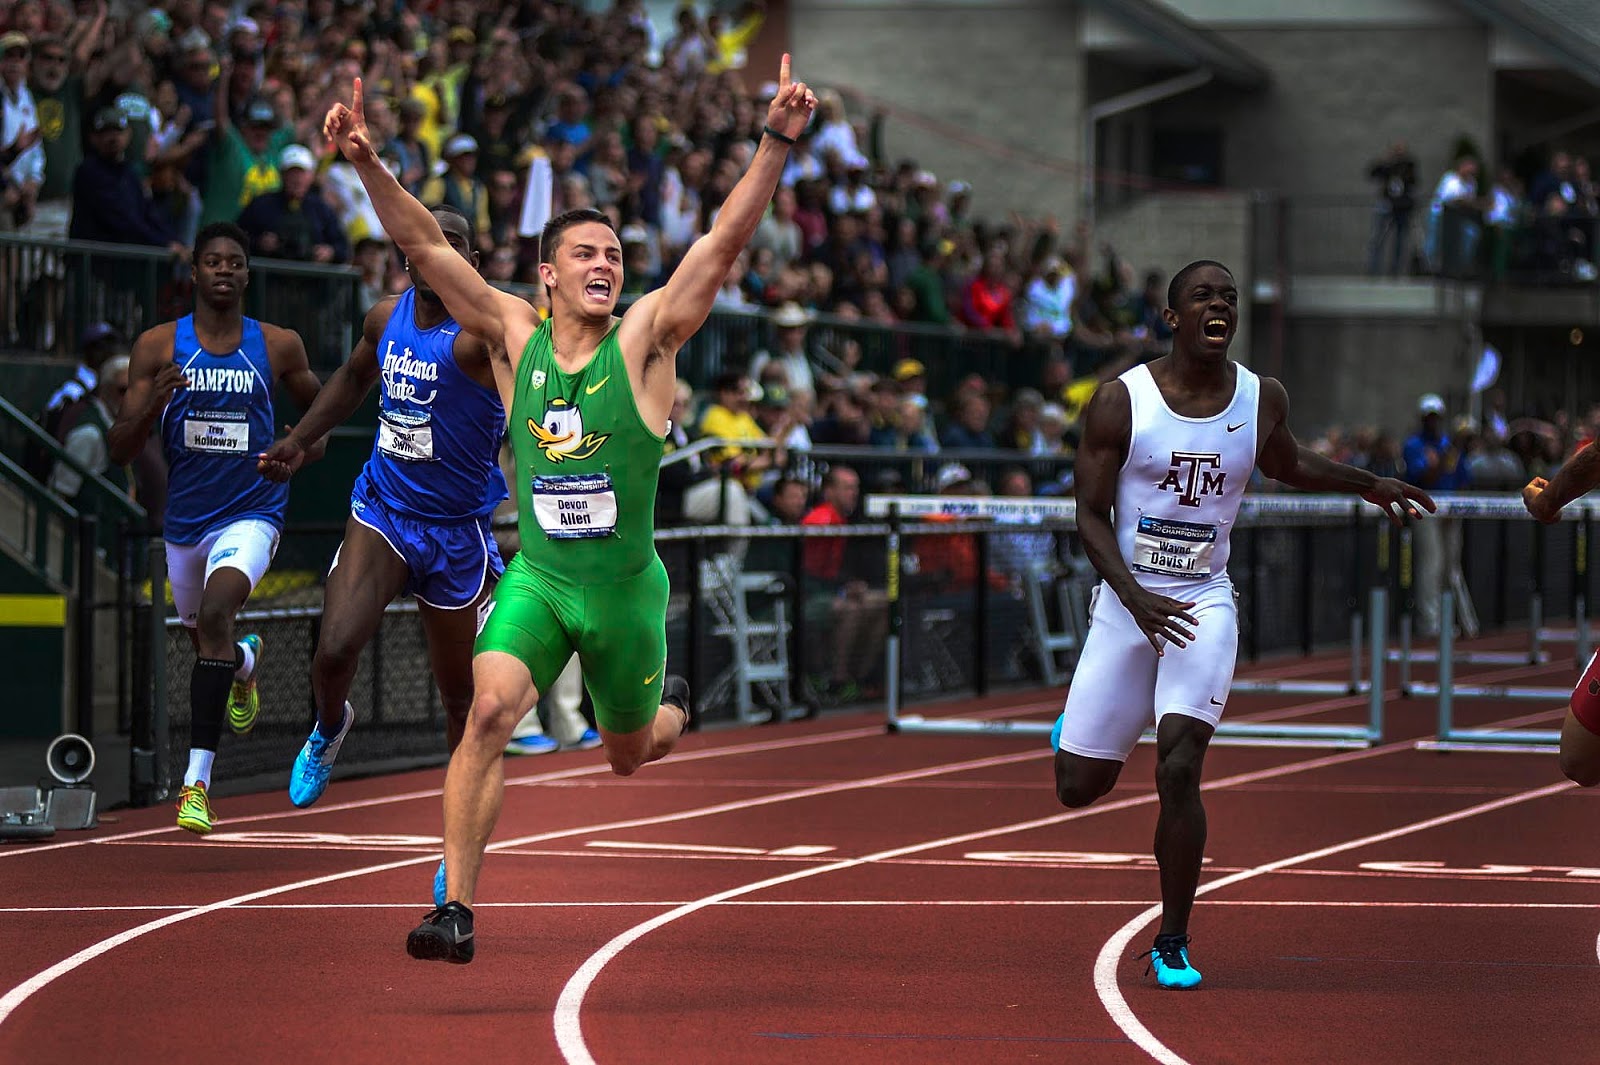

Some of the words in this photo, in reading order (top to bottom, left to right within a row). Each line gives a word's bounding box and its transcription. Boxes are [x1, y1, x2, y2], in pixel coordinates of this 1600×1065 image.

[382, 340, 438, 381] Indiana
[185, 368, 255, 394] HAMPTON
[382, 370, 437, 405] State
[194, 435, 238, 448] Holloway
[558, 499, 588, 511] Devon
[560, 513, 591, 526] Allen
[1159, 541, 1191, 554] Wayne
[1151, 552, 1183, 569] Davis
[1186, 558, 1196, 570] II
